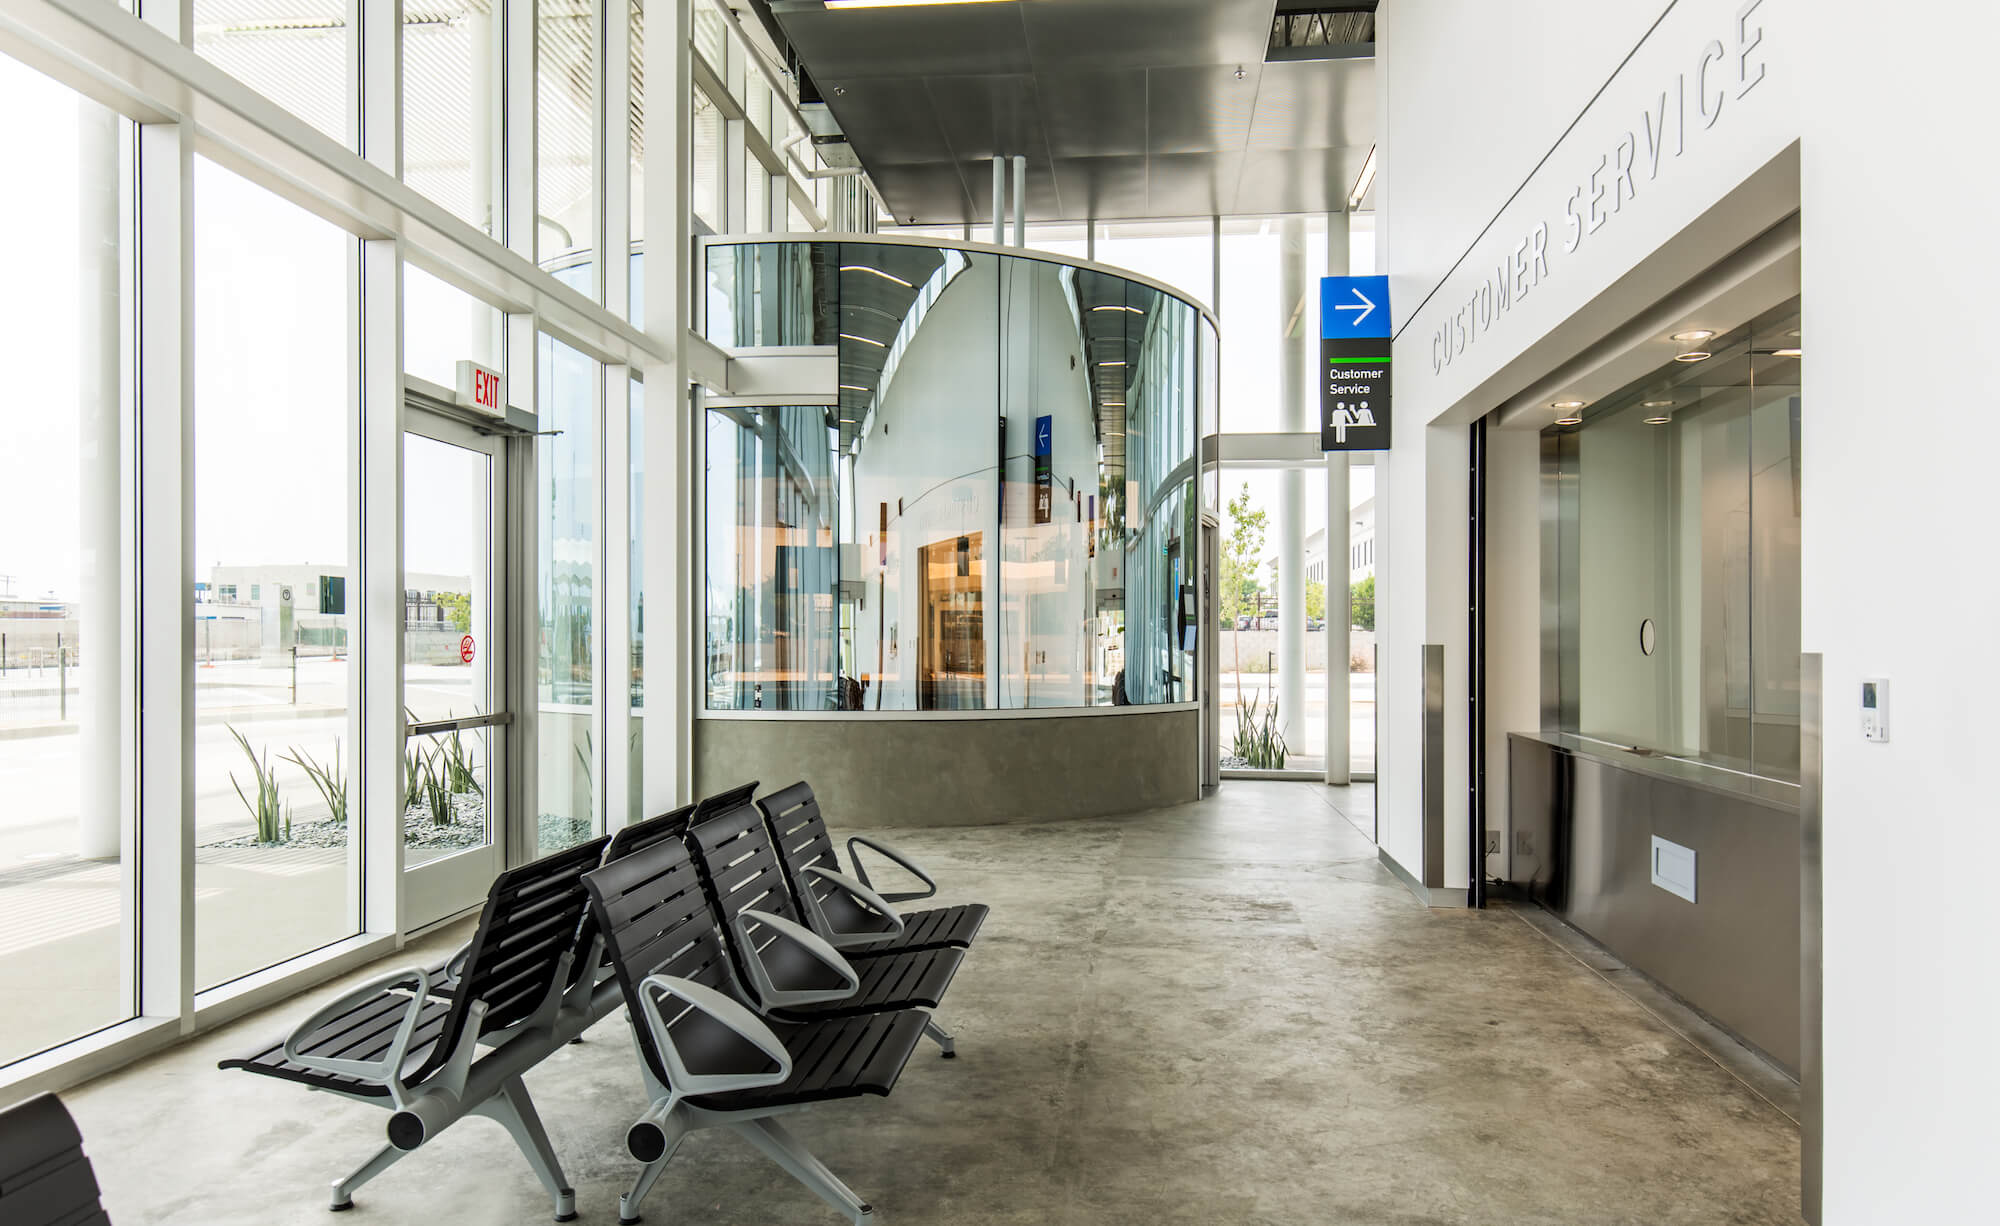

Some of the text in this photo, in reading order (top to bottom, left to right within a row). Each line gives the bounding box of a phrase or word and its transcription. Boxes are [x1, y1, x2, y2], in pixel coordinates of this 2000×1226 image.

[1431, 0, 1765, 376] CUSTOMER SERVICE
[1330, 369, 1383, 380] Customer
[476, 369, 499, 409] EXIT
[1330, 384, 1370, 395] Service
